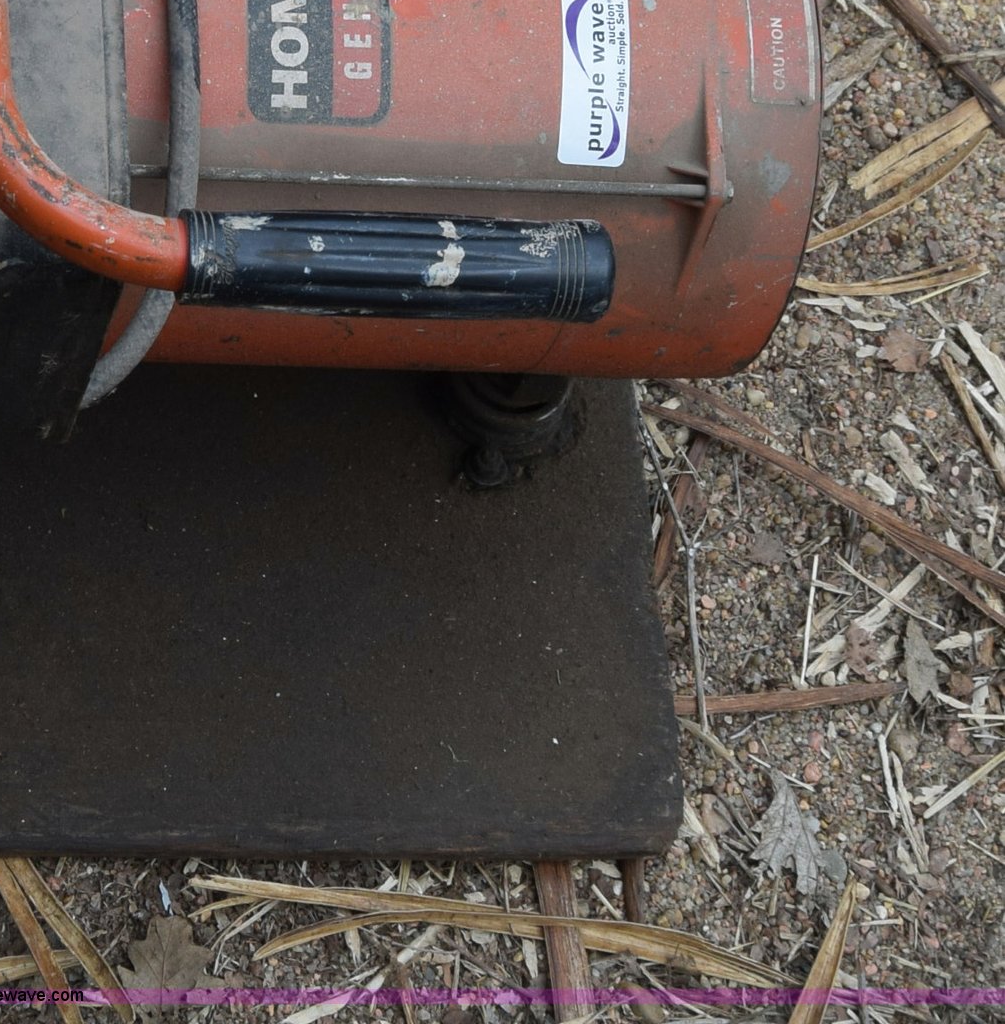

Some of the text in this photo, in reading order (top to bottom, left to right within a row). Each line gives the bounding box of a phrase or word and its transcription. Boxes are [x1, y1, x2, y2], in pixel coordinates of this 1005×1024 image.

[587, 3, 607, 152] purple wave
[616, 1, 627, 112] Straight. Simple. Sold.
[769, 17, 786, 90] CAUTION
